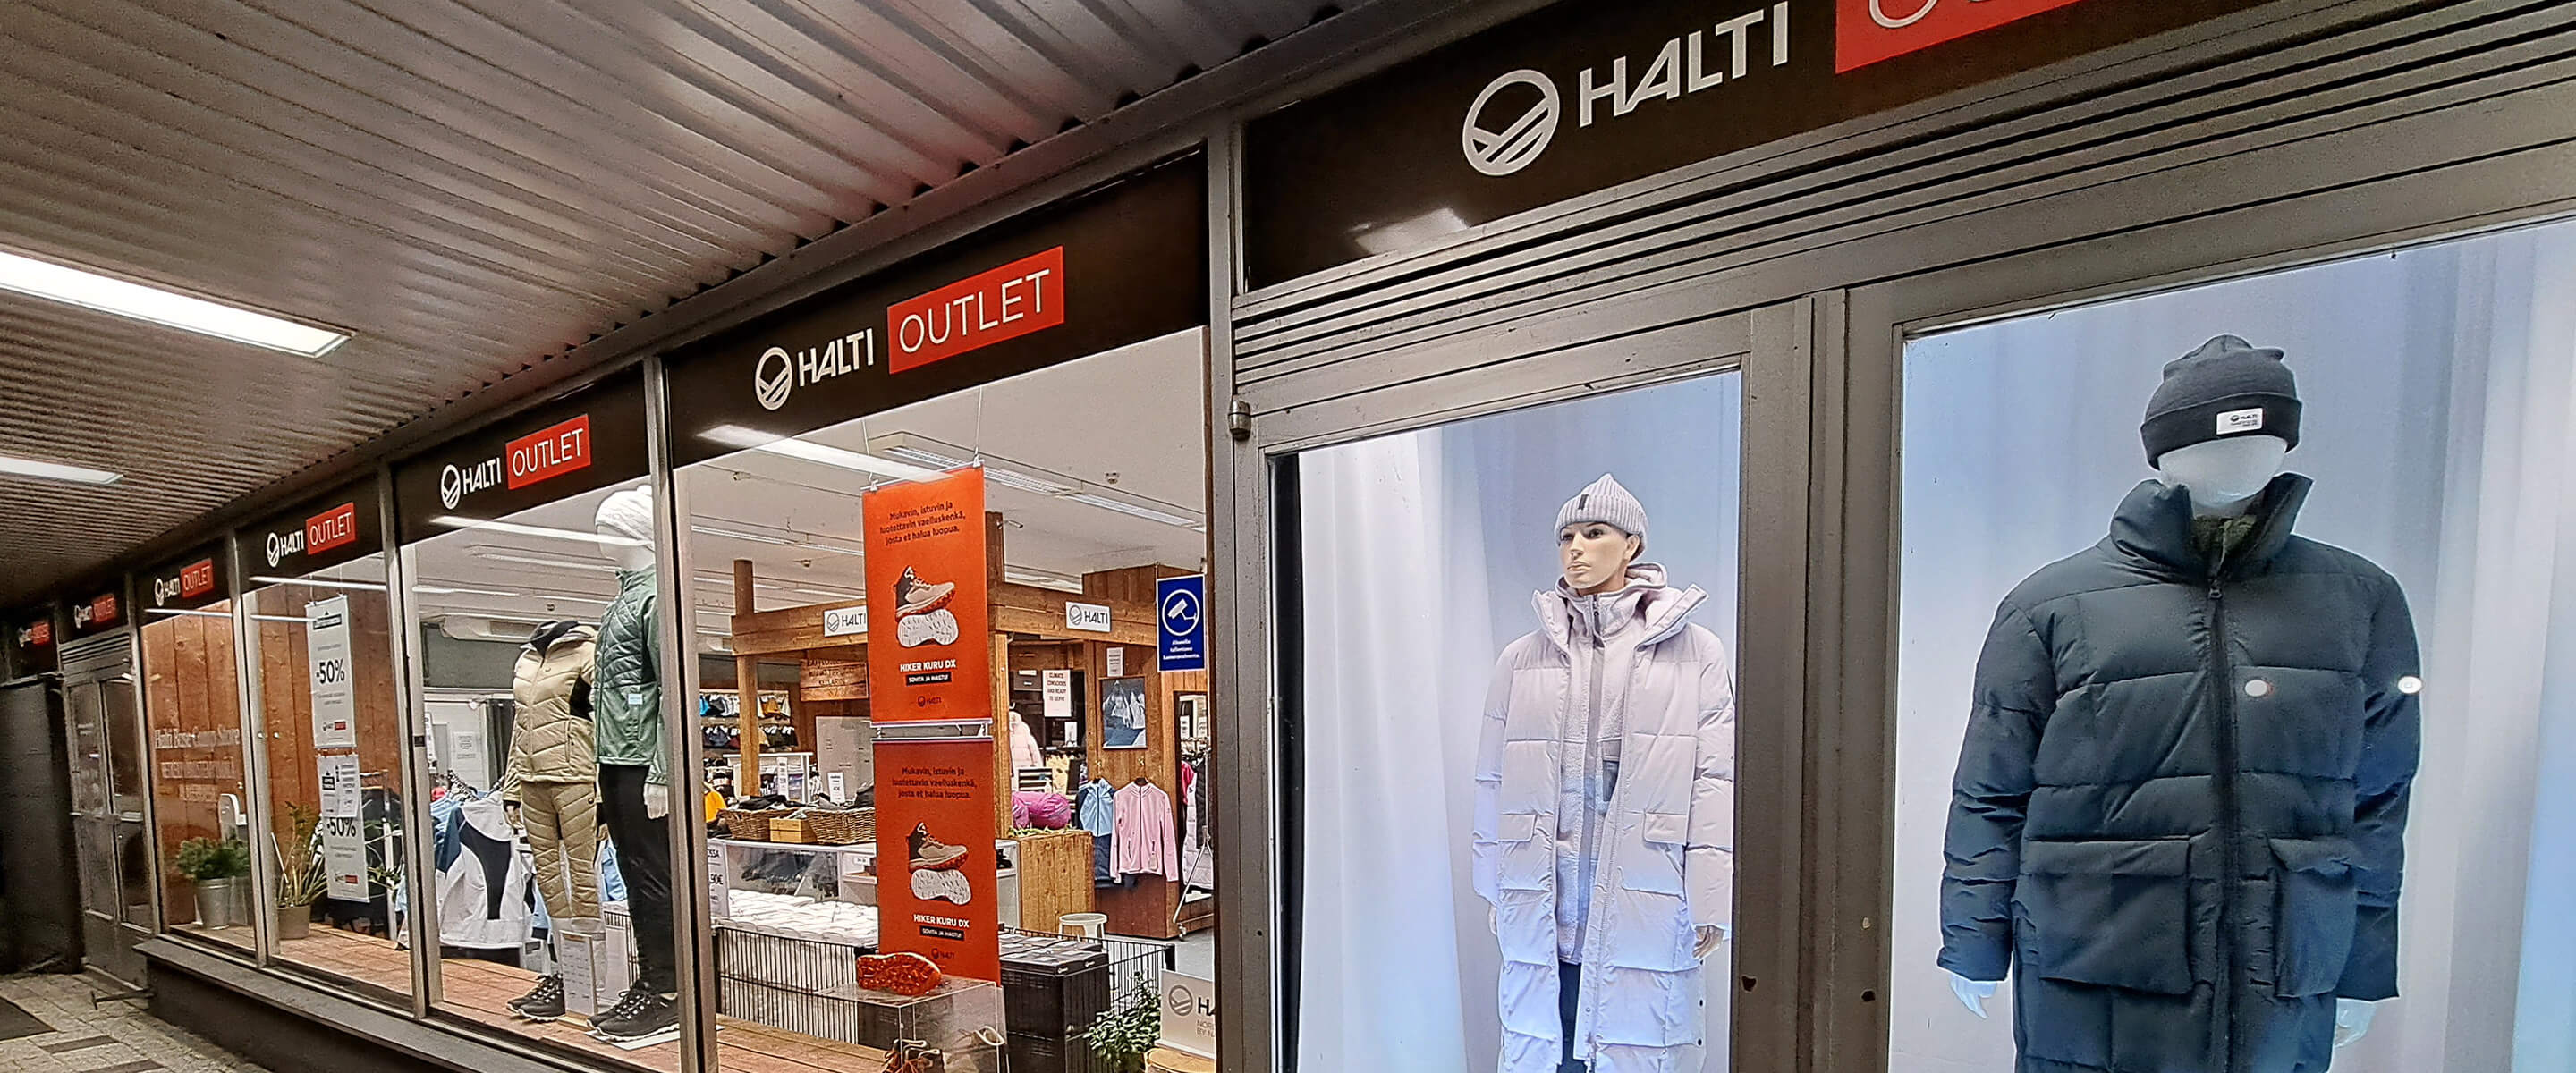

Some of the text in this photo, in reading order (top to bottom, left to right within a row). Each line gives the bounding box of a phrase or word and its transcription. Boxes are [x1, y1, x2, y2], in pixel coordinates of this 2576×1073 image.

[1579, 0, 1789, 128] HALTI
[798, 269, 1050, 387] HALTI OUTLET
[462, 427, 583, 494] HALTI OUTLET
[945, 501, 953, 511] ja
[280, 512, 352, 556] HALTI OUTLET
[903, 533, 911, 542] et
[183, 566, 210, 591] OUTLET
[842, 613, 866, 627] HALTI
[1084, 610, 1109, 625] HALTI
[316, 658, 345, 684] -50%
[900, 659, 956, 672] HIKER KURU DX
[957, 767, 965, 776] ja
[913, 914, 970, 928] HIKER KURU DX
